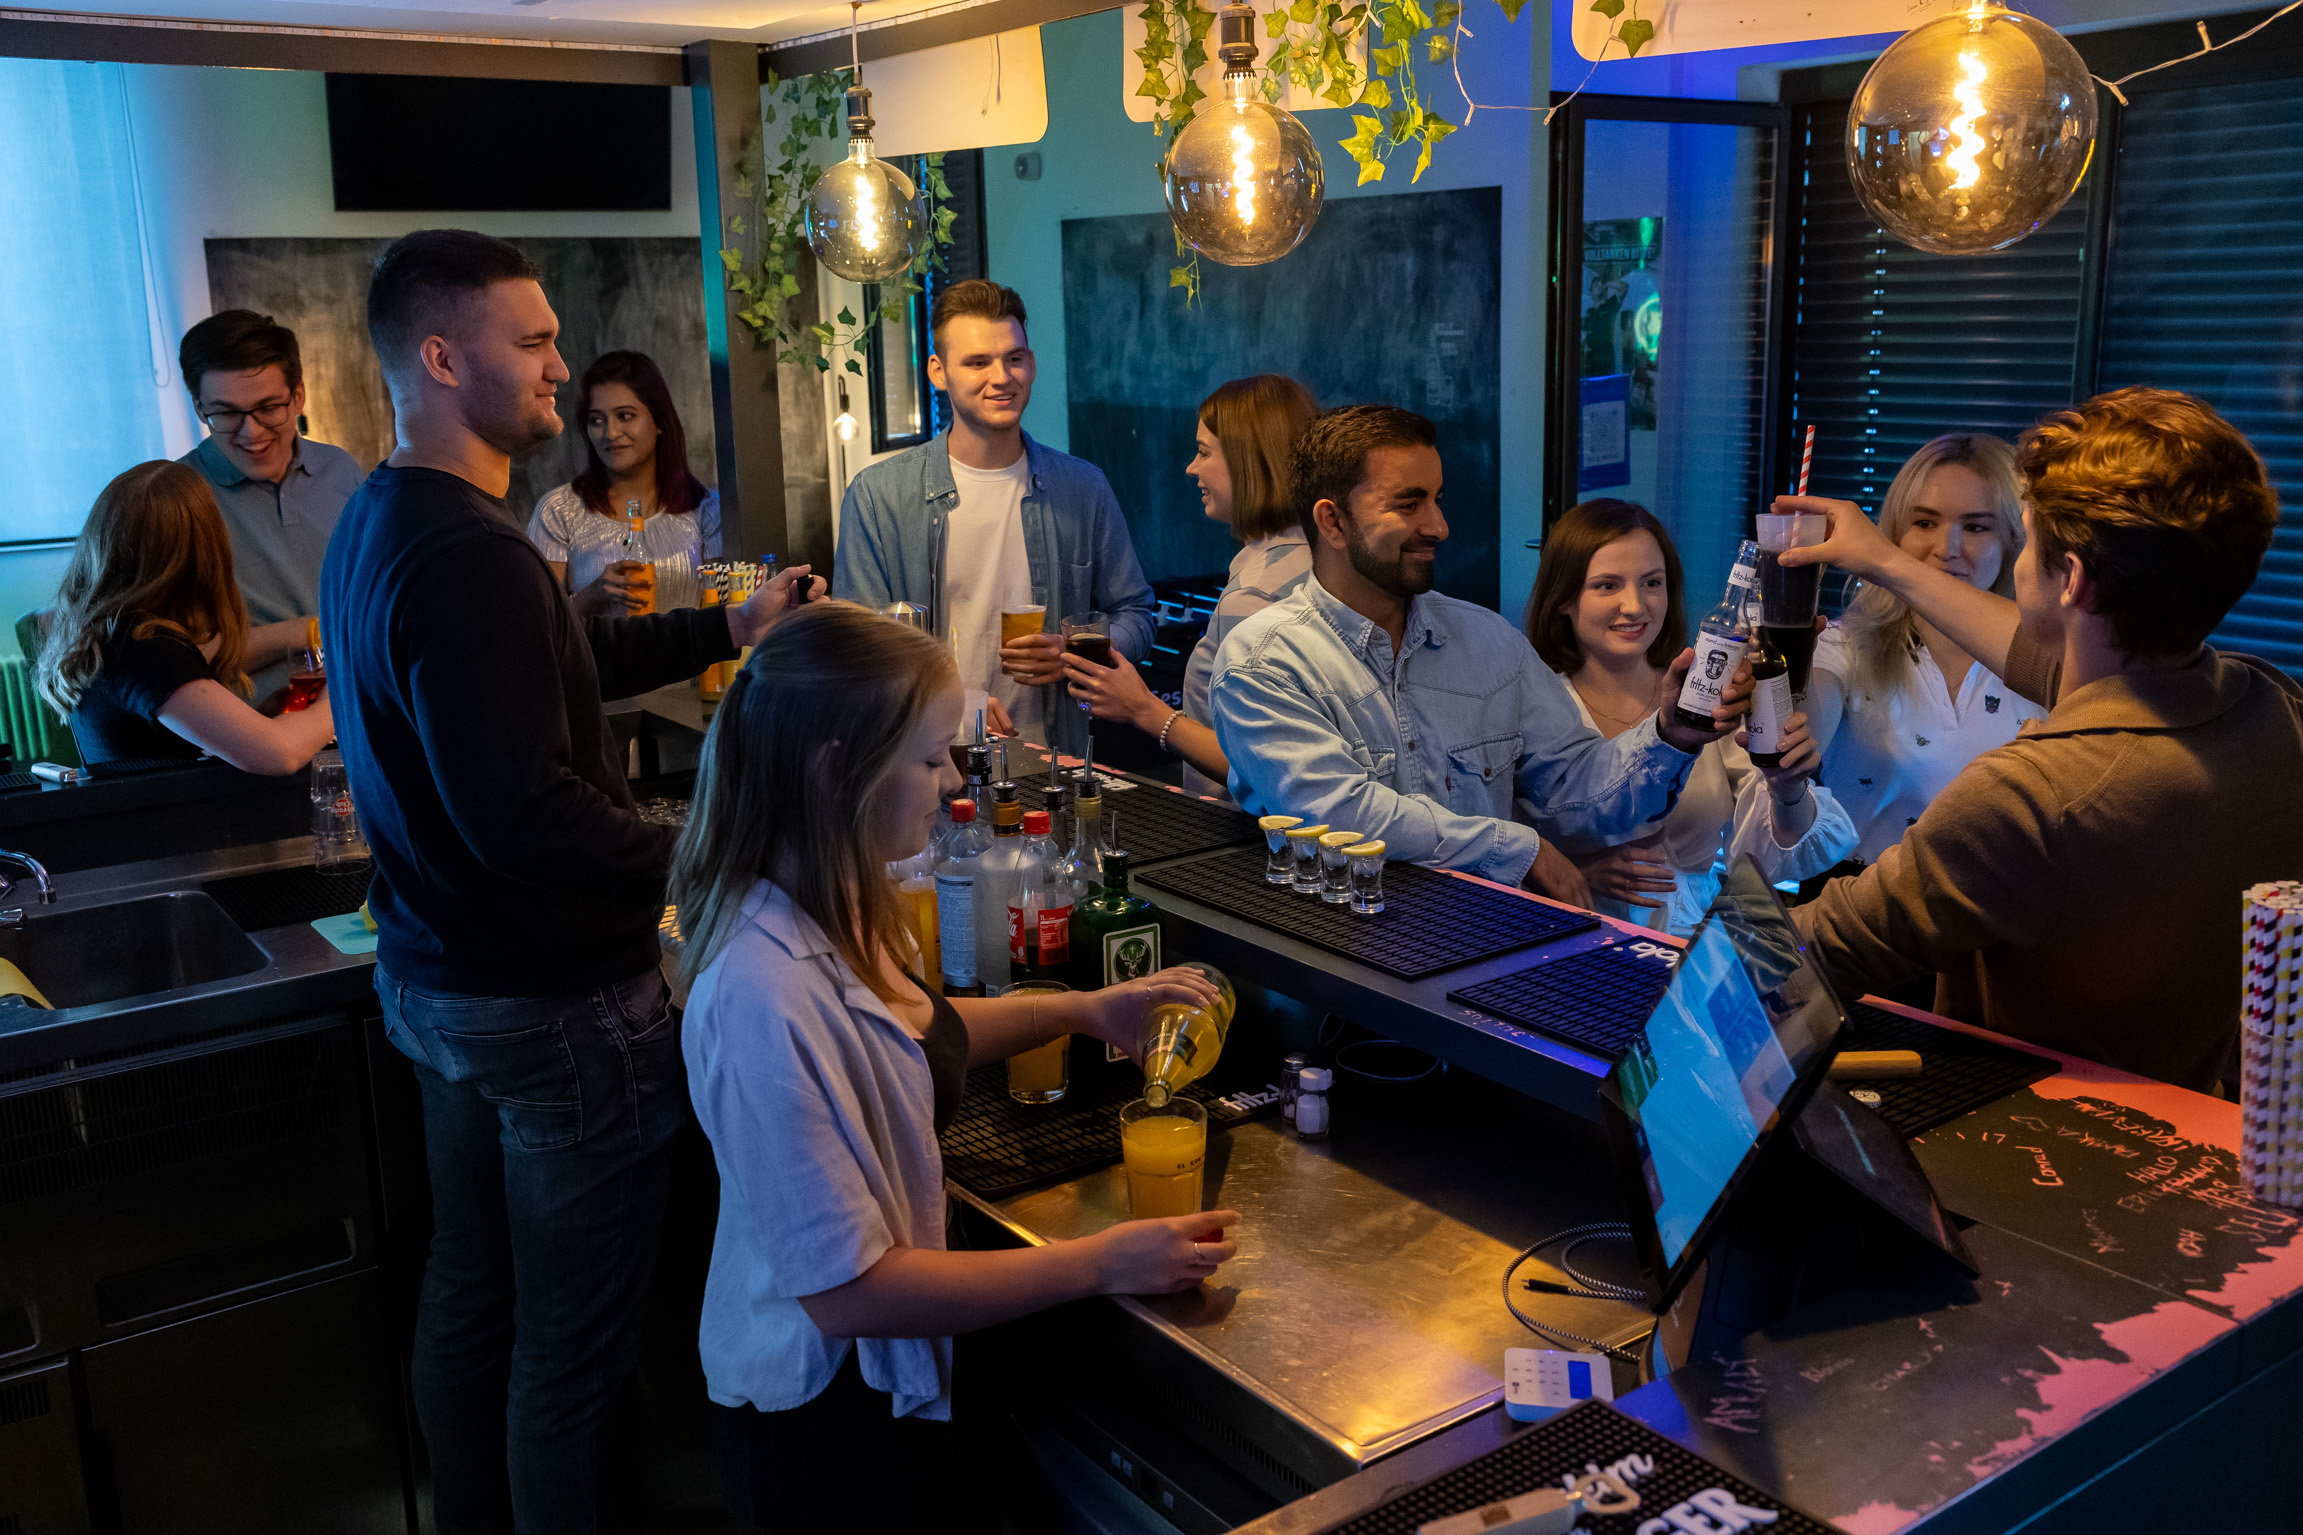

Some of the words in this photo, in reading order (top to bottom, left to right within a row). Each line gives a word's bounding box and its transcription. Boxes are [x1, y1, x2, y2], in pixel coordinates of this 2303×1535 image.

[1733, 569, 1755, 583] fritz-kol
[1689, 676, 1723, 697] fritz-kol
[2015, 1146, 2064, 1187] Conrad
[2125, 1156, 2178, 1184] HALLO
